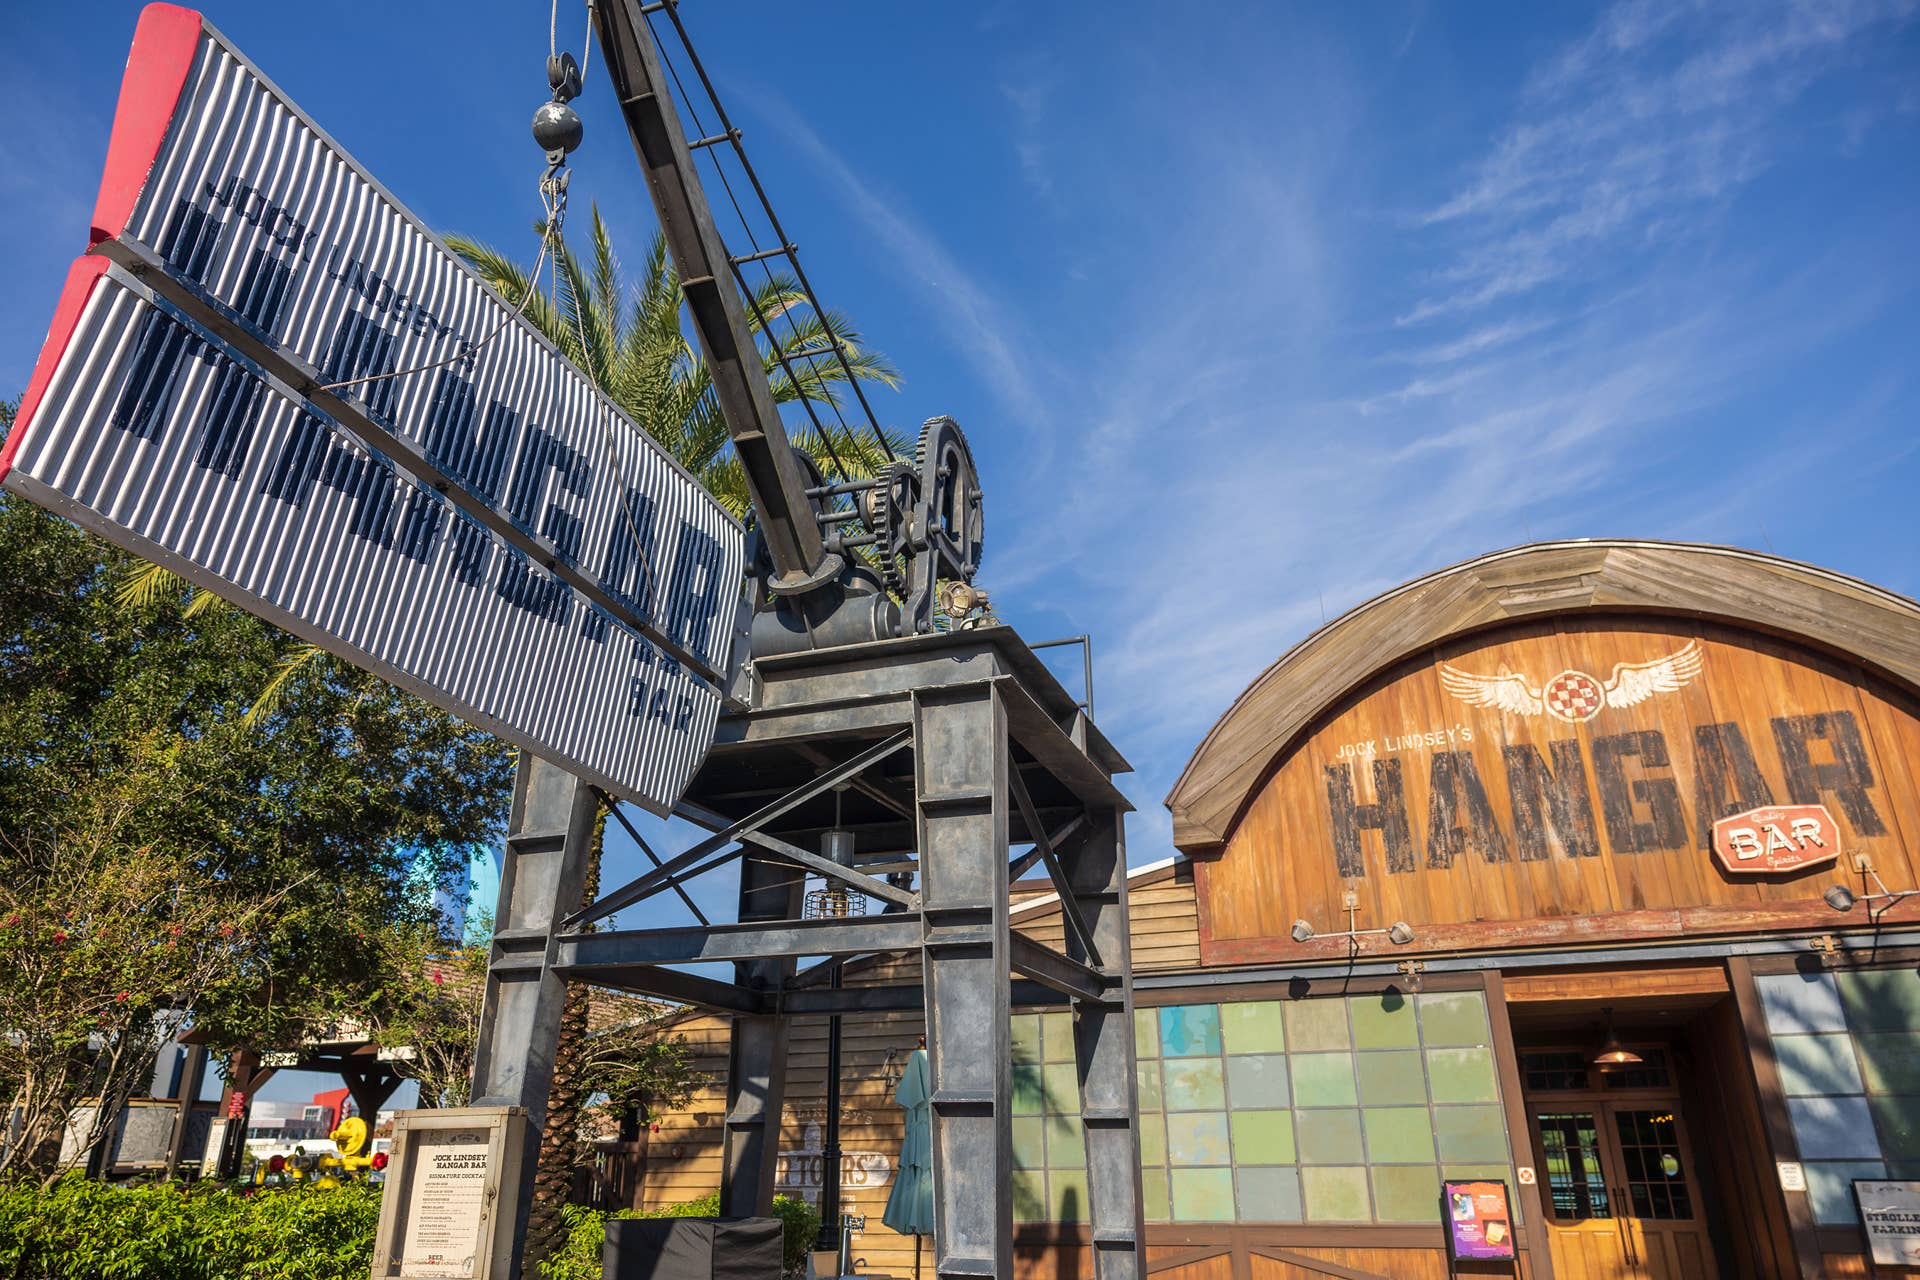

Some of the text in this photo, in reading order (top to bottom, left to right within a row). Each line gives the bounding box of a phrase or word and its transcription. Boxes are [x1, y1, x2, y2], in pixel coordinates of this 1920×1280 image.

[206, 175, 478, 373] JOCK LINDSEY'S
[627, 674, 694, 735] BAR
[1335, 723, 1474, 759] JOCK LINDSEY'S
[1323, 709, 1889, 879] HANGAR
[1728, 817, 1828, 860] BAR
